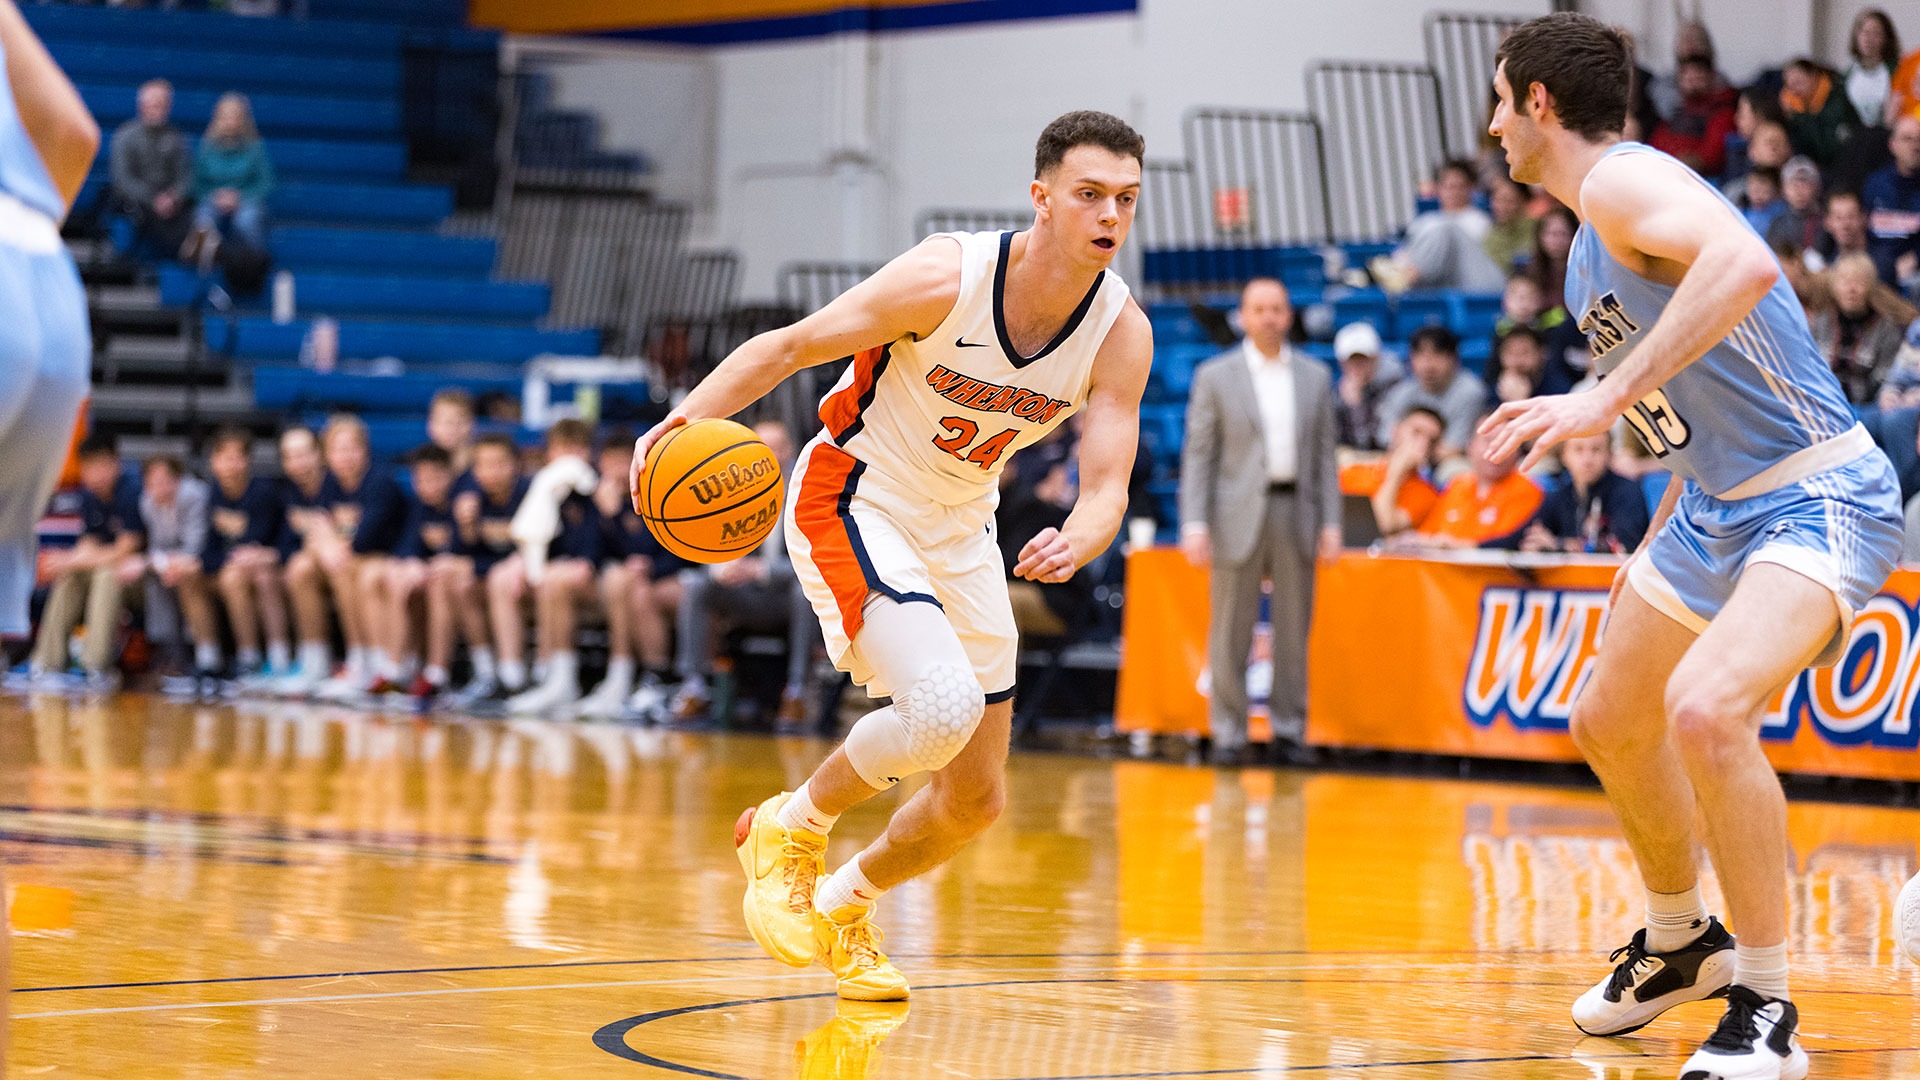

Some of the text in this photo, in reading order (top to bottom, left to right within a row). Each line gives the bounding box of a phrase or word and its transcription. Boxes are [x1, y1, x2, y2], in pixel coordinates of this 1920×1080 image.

[925, 364, 1071, 424] WHEATON
[932, 416, 1021, 470] 24
[688, 457, 775, 505] Wilson
[720, 498, 777, 540] NCAA
